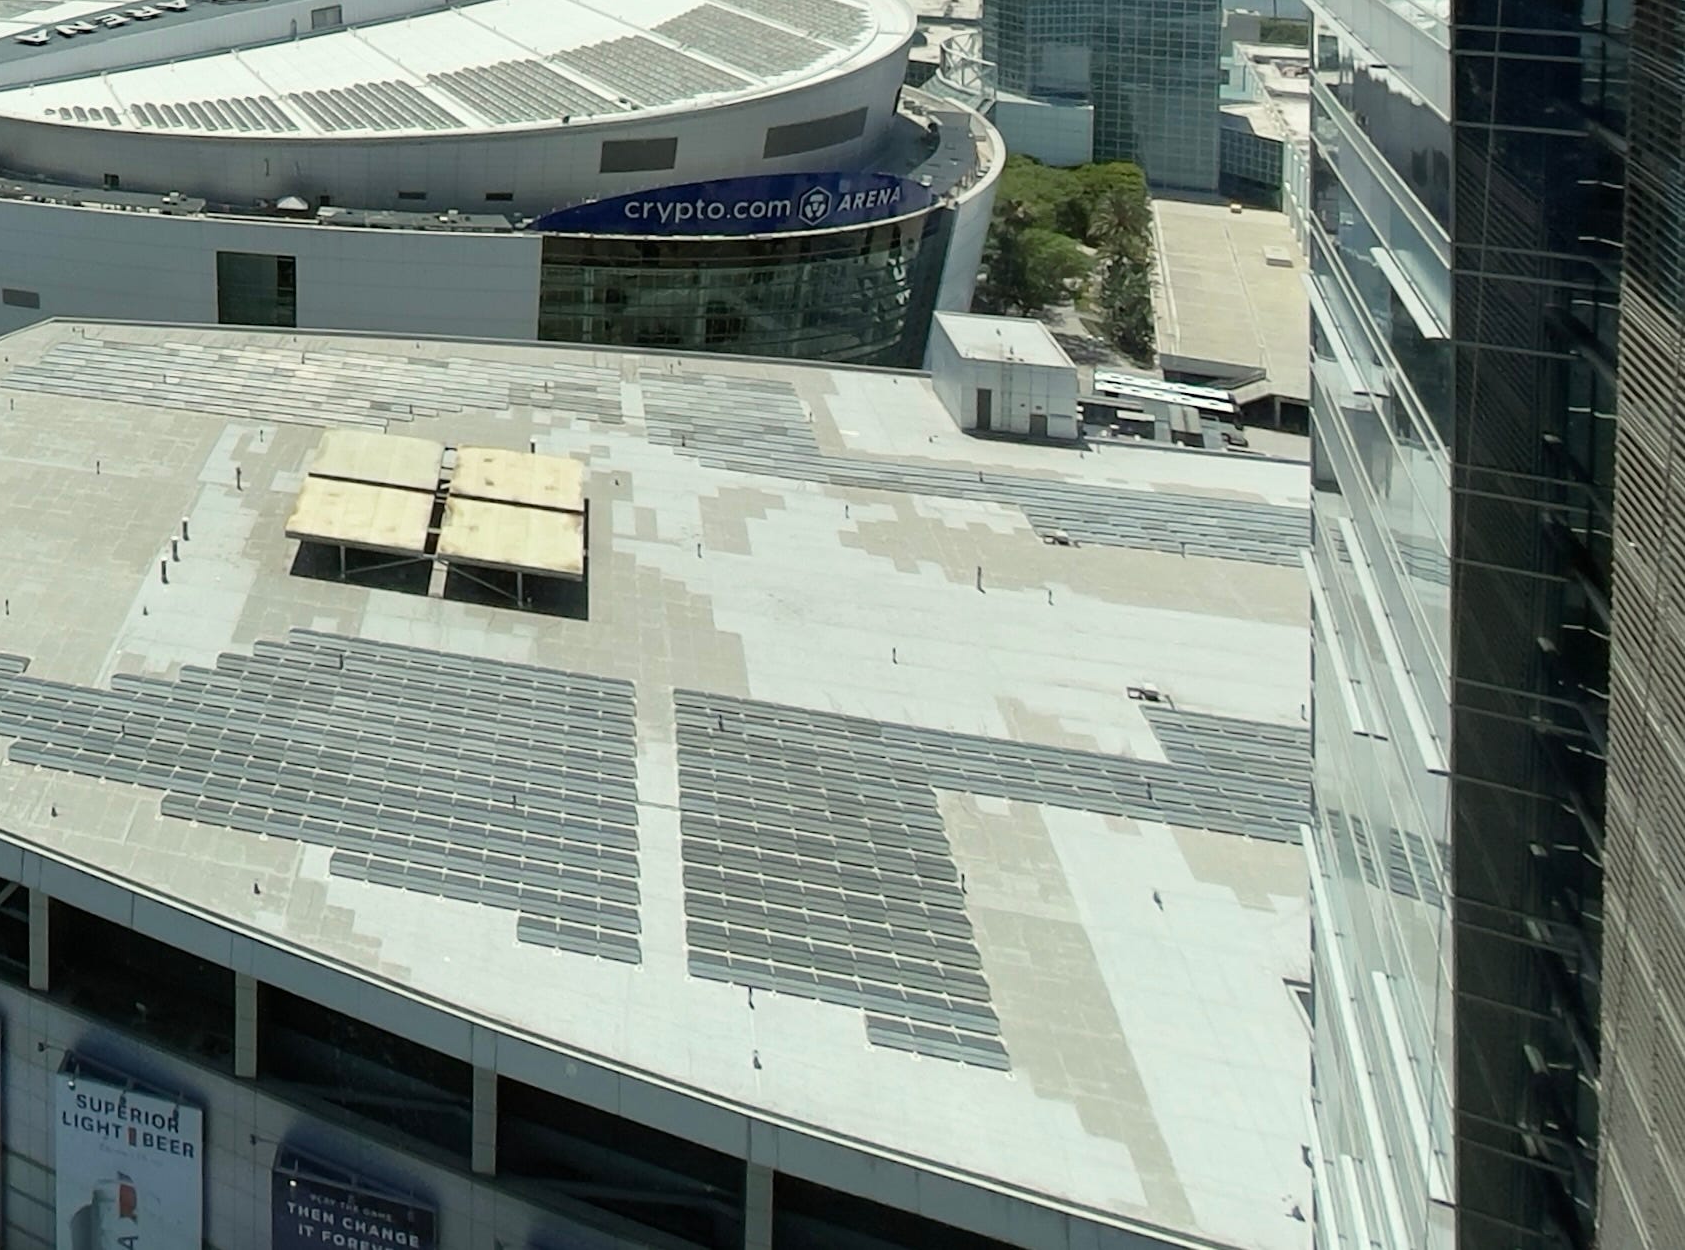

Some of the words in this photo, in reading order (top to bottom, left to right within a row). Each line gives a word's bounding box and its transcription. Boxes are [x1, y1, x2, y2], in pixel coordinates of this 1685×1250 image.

[624, 199, 791, 223] crypto.com
[836, 186, 902, 212] ARENA
[76, 1093, 179, 1134] SUPERIOR
[62, 1111, 122, 1139] LIGHT
[142, 1132, 195, 1159] BEER
[287, 1201, 335, 1226] THEN
[342, 1217, 420, 1248] CHANGE
[298, 1223, 314, 1237] IT
